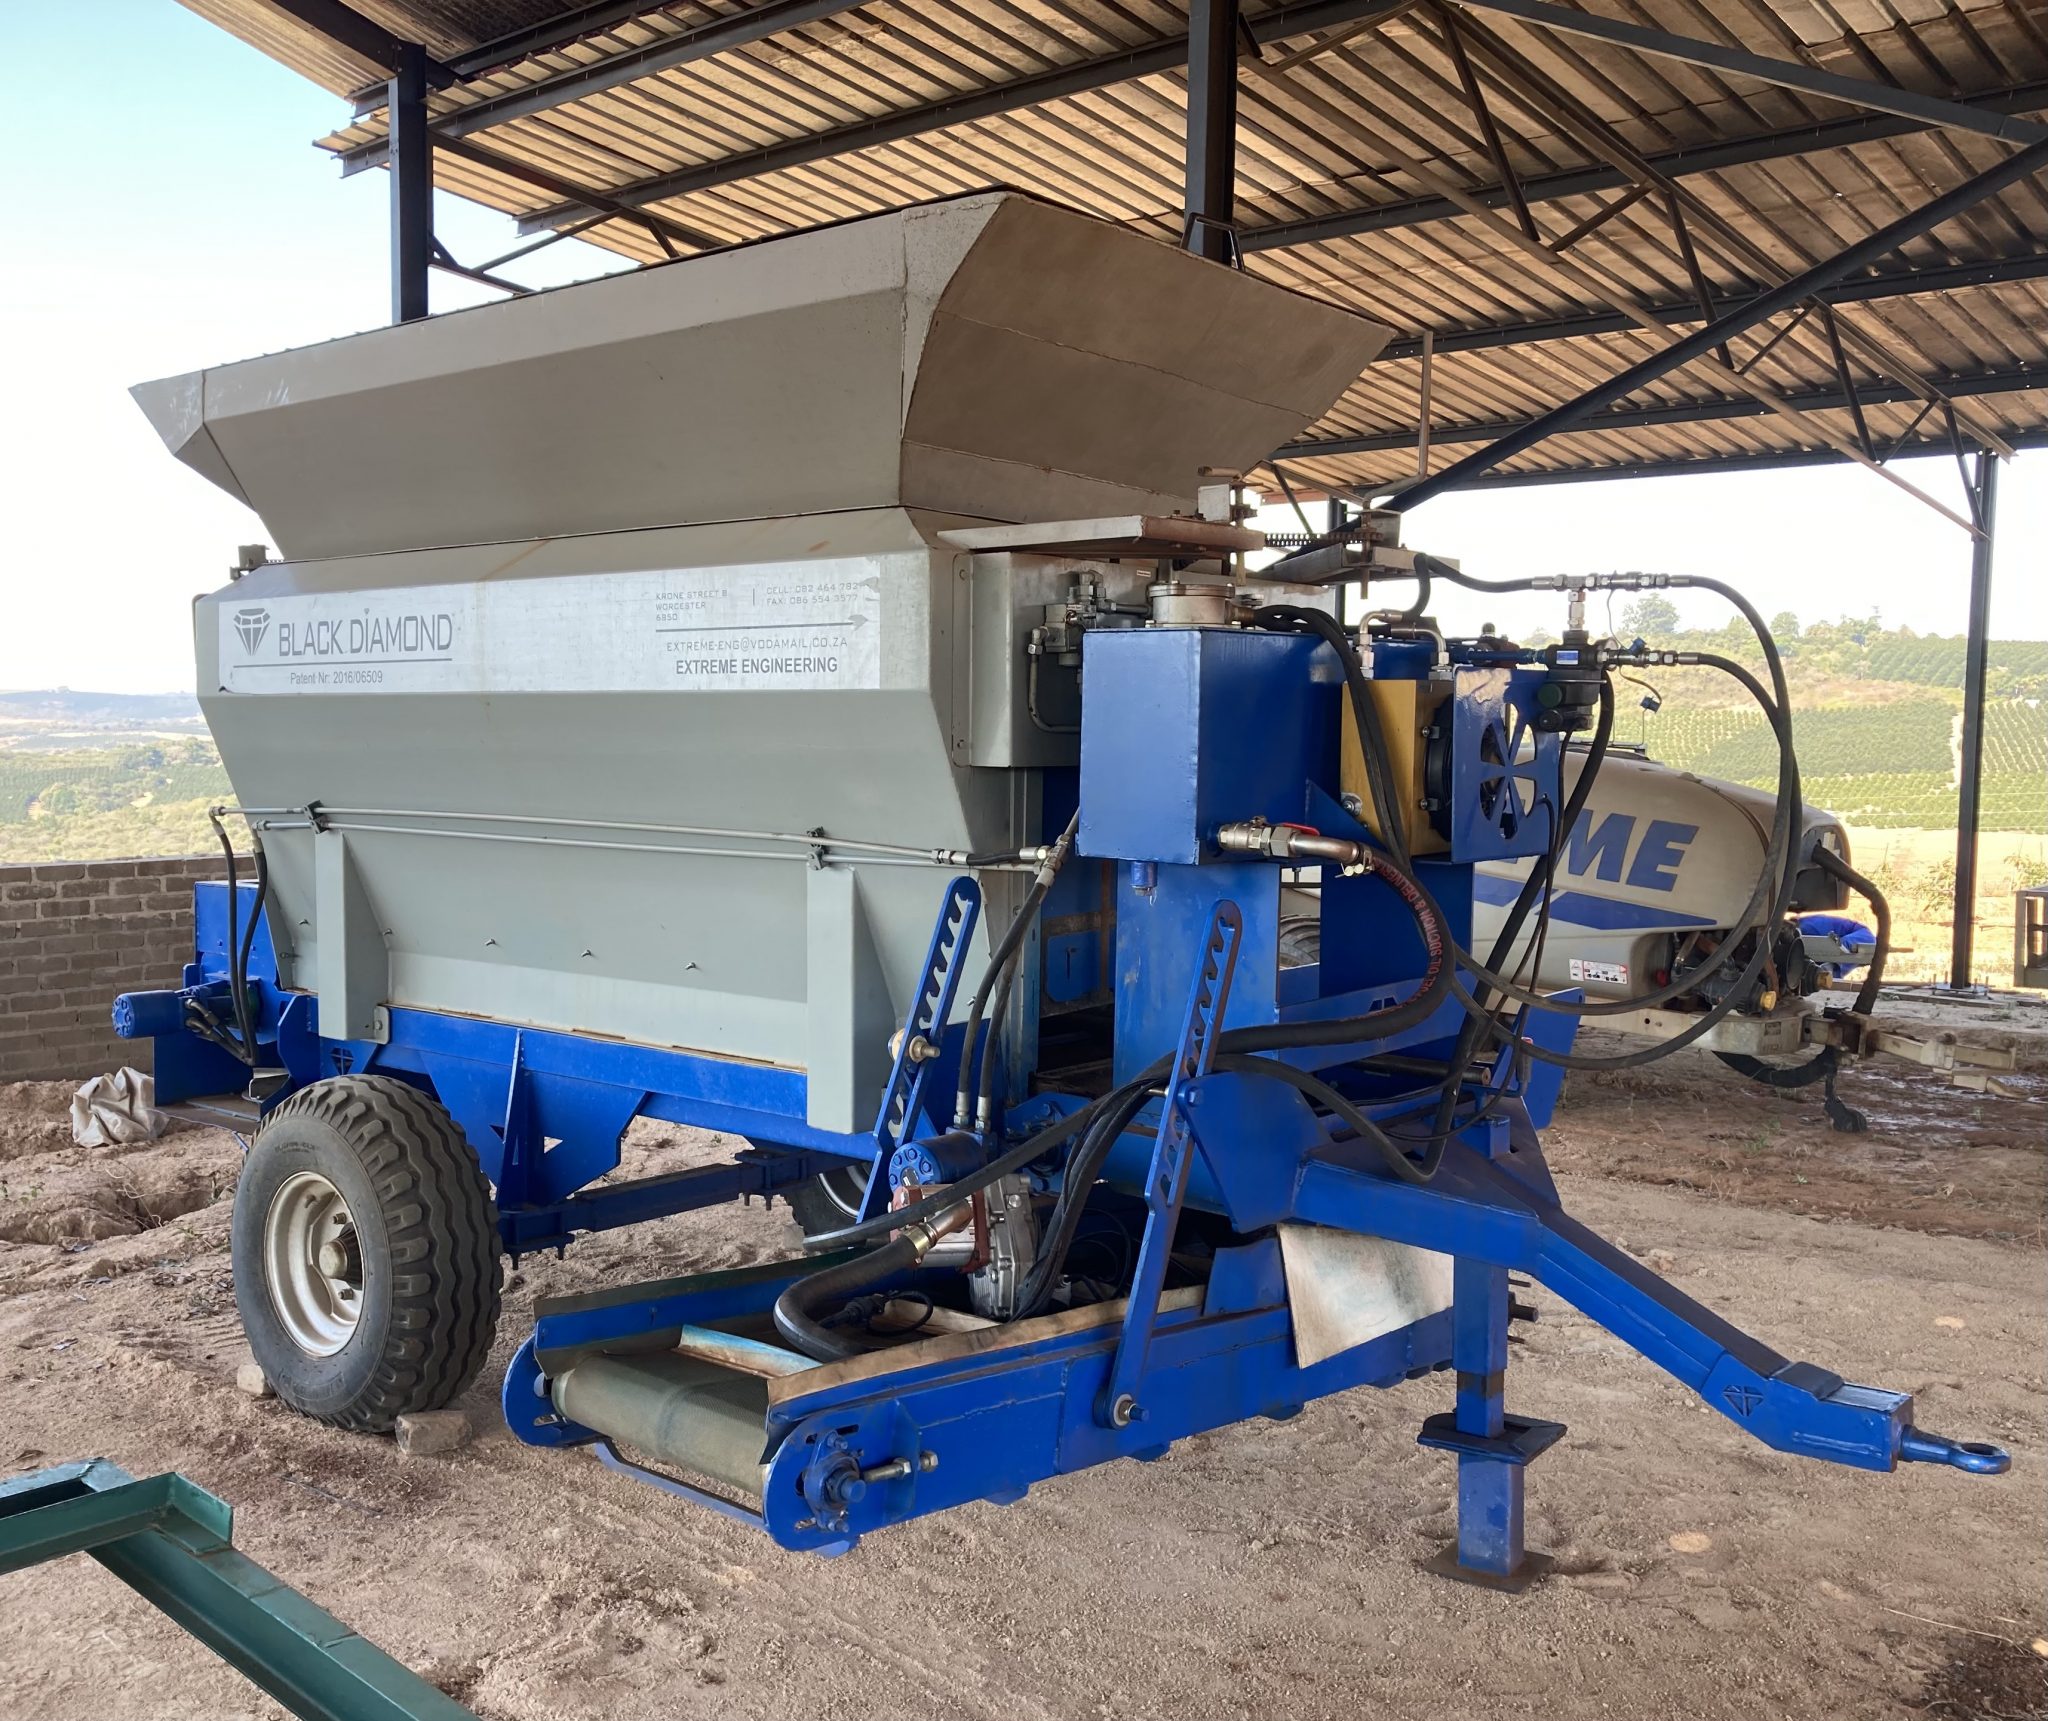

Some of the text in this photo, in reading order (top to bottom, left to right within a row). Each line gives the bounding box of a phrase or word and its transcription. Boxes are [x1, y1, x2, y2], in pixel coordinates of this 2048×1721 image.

[656, 592, 684, 601] KRONE
[686, 590, 719, 599] STREET
[656, 601, 706, 611] WORCESTER
[279, 619, 344, 657] BLACK
[676, 656, 838, 675] EXTREME ENGINEERING
[290, 672, 316, 684] Patent
[333, 670, 383, 684] 2016/06509
[1419, 908, 1443, 957] SUCTION
